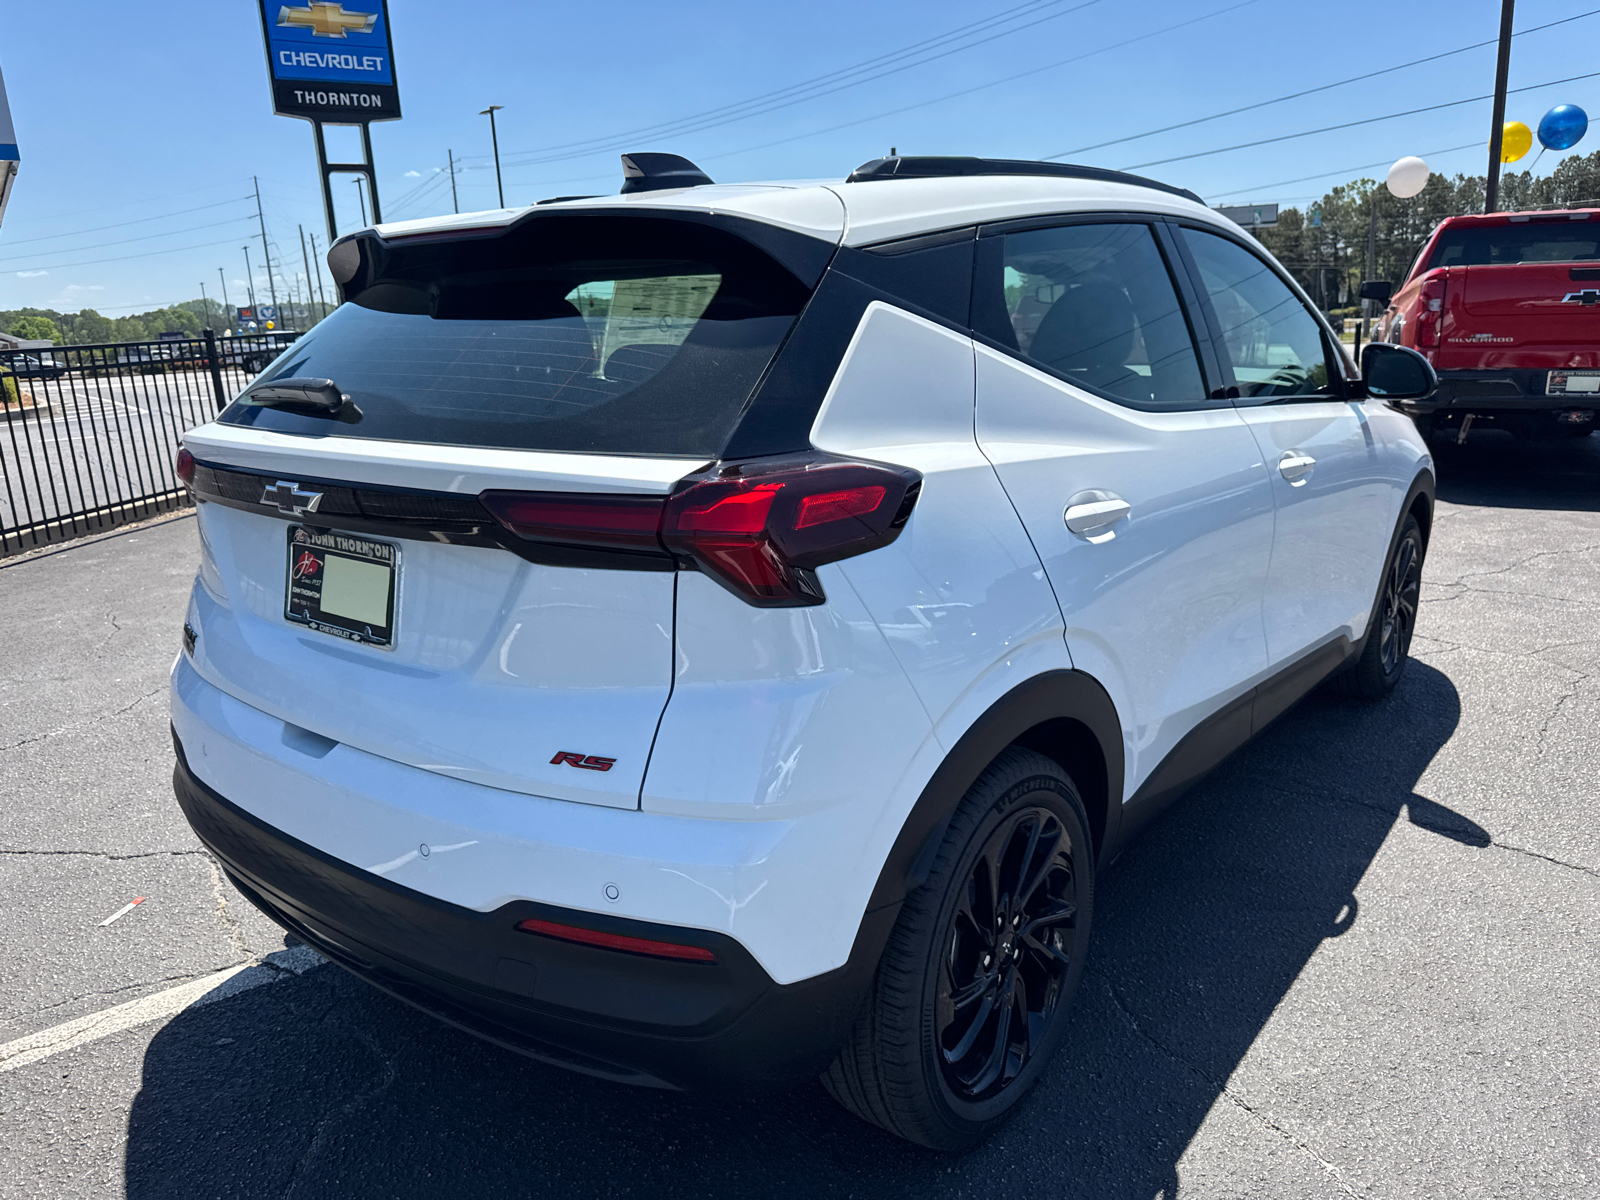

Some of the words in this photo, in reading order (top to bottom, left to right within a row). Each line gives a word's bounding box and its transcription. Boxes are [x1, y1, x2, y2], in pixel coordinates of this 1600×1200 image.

[279, 51, 384, 71] CHEVROLET
[294, 90, 382, 107] THORNTON
[311, 534, 335, 548] JOHN
[319, 624, 351, 639] CHEVROLET
[549, 751, 617, 771] RS
[1010, 778, 1056, 802] MICHELIN
